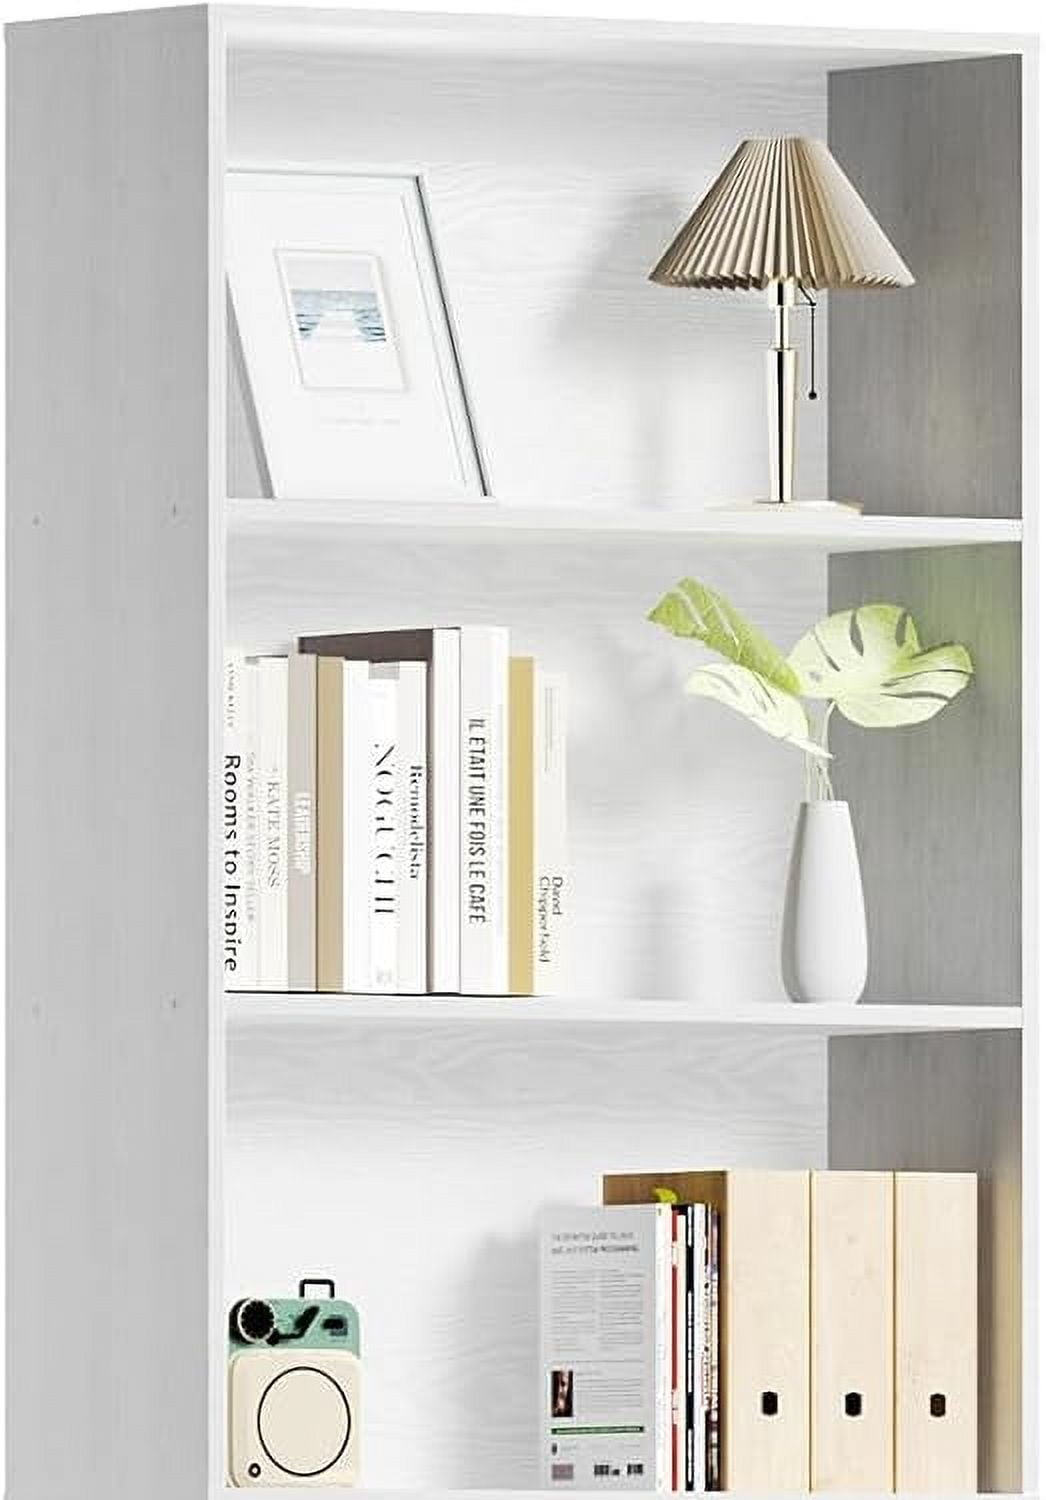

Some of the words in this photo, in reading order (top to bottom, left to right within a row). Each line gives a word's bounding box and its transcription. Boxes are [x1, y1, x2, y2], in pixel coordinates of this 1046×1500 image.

[223, 755, 241, 839] Rooms
[468, 786, 486, 817] UNE
[468, 822, 486, 857] FOIS
[224, 847, 240, 876] to
[468, 861, 486, 879] LE
[223, 885, 242, 972] Inspire
